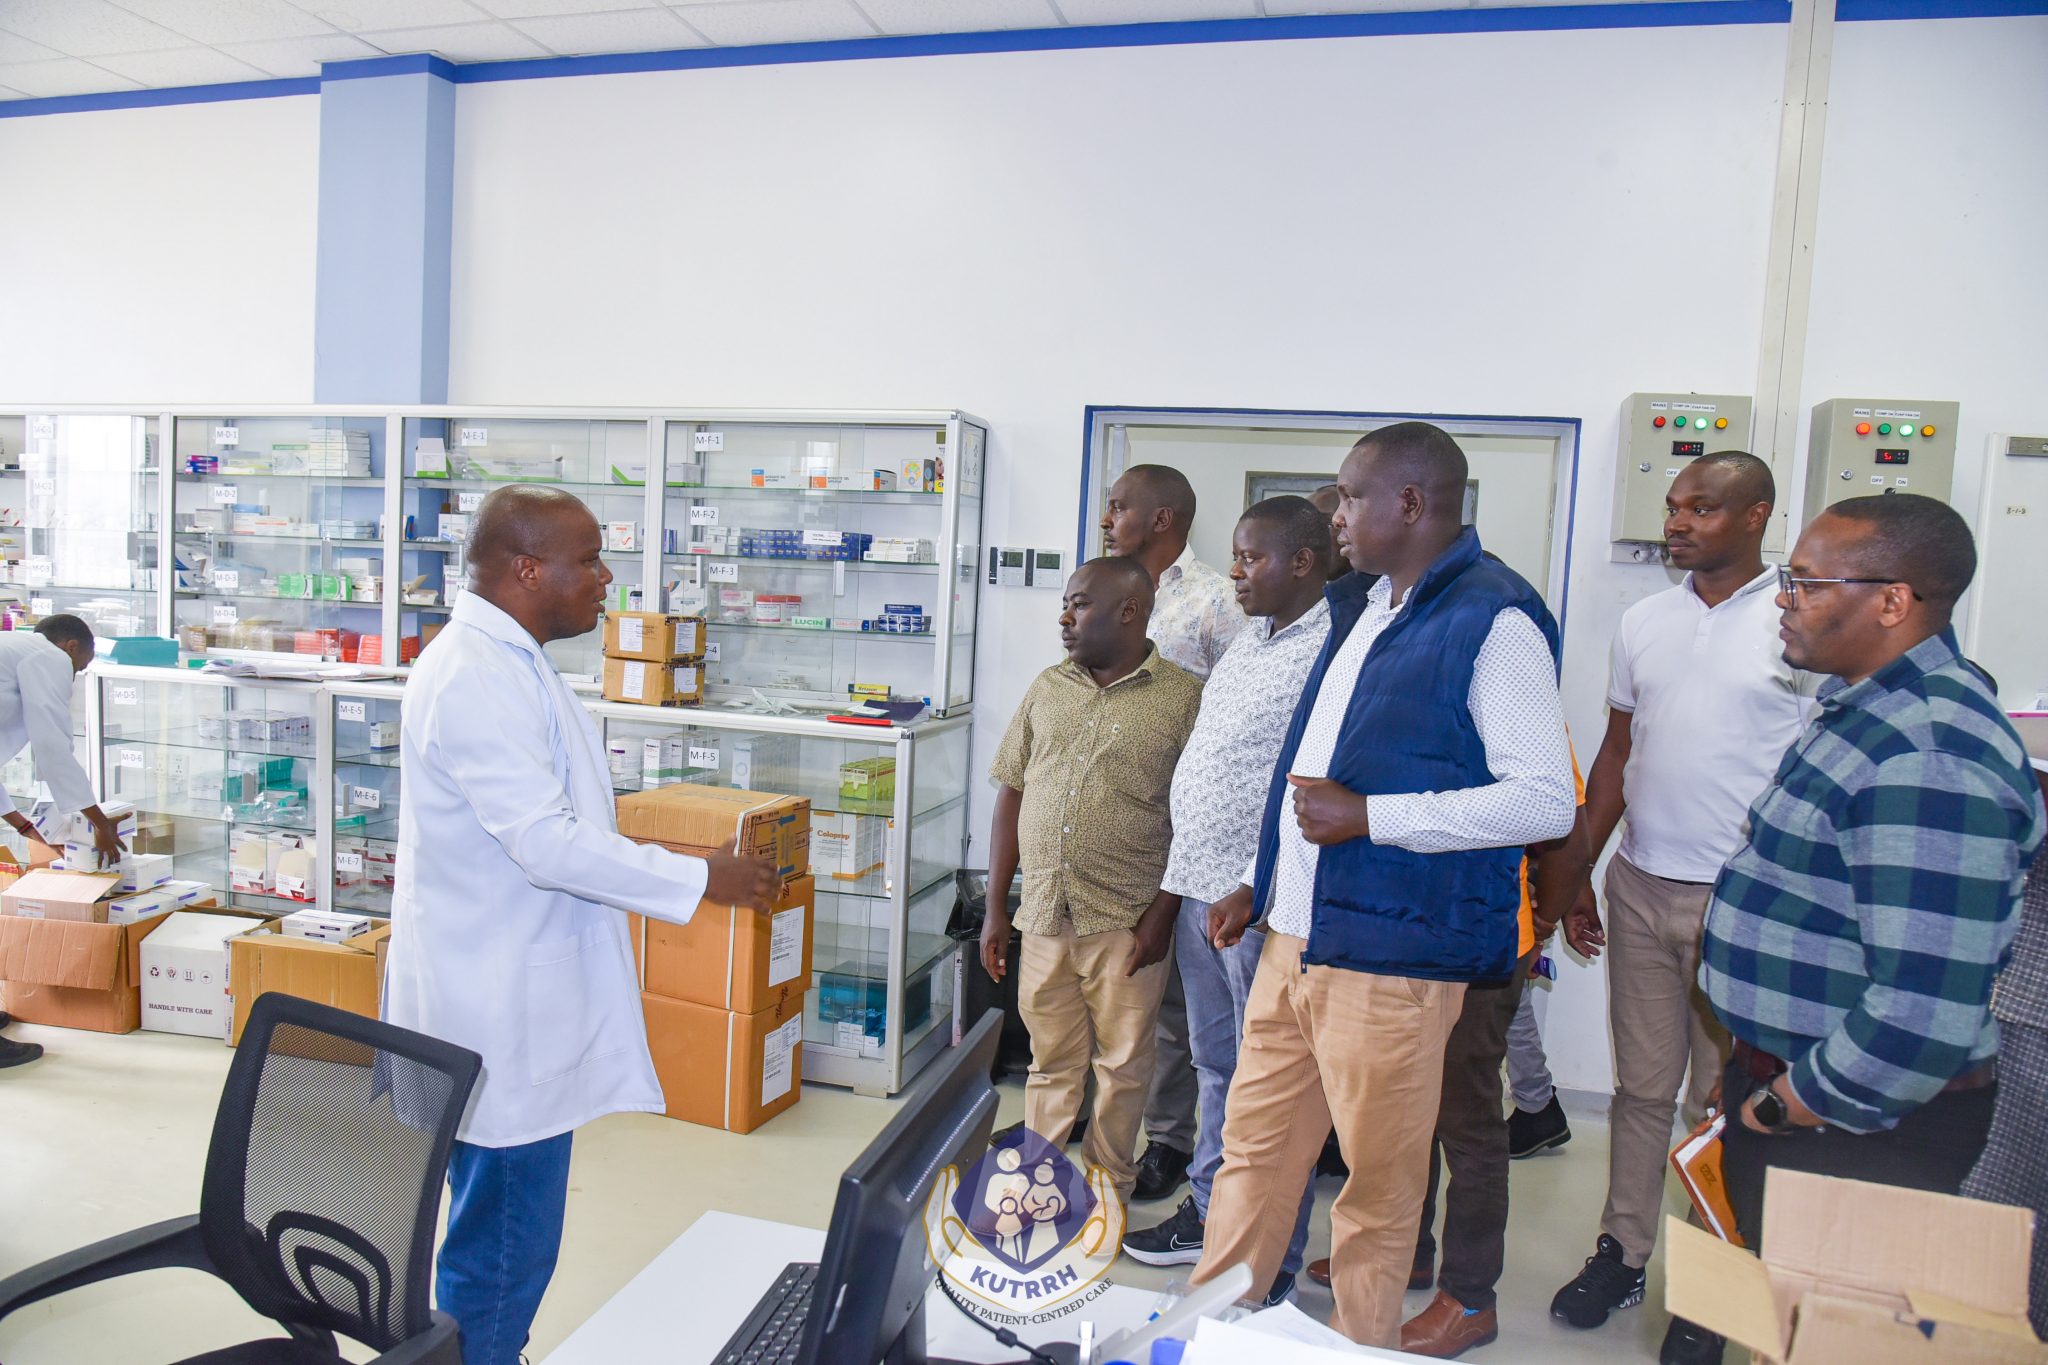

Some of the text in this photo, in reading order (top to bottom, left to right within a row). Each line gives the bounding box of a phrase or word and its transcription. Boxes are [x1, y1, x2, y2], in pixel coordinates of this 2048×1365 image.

[216, 430, 237, 439] M-D-1
[463, 431, 484, 440] M-E-1
[696, 436, 720, 445] M-F-1
[215, 490, 236, 498] M-D-2
[691, 510, 716, 519] M-F-2
[709, 566, 734, 575] M-F-3
[216, 573, 236, 582] M-D-3
[214, 609, 235, 617] M-D-4
[794, 618, 823, 626] LUCIN
[115, 690, 136, 699] M-D-5
[340, 704, 362, 715] M-E-5
[122, 753, 143, 762] M-D-6
[690, 751, 716, 761] M-F-5
[354, 789, 377, 801] M-E-6
[337, 855, 360, 865] M-E-7
[148, 1003, 175, 1012] HANDLE
[176, 1006, 194, 1014] WITH
